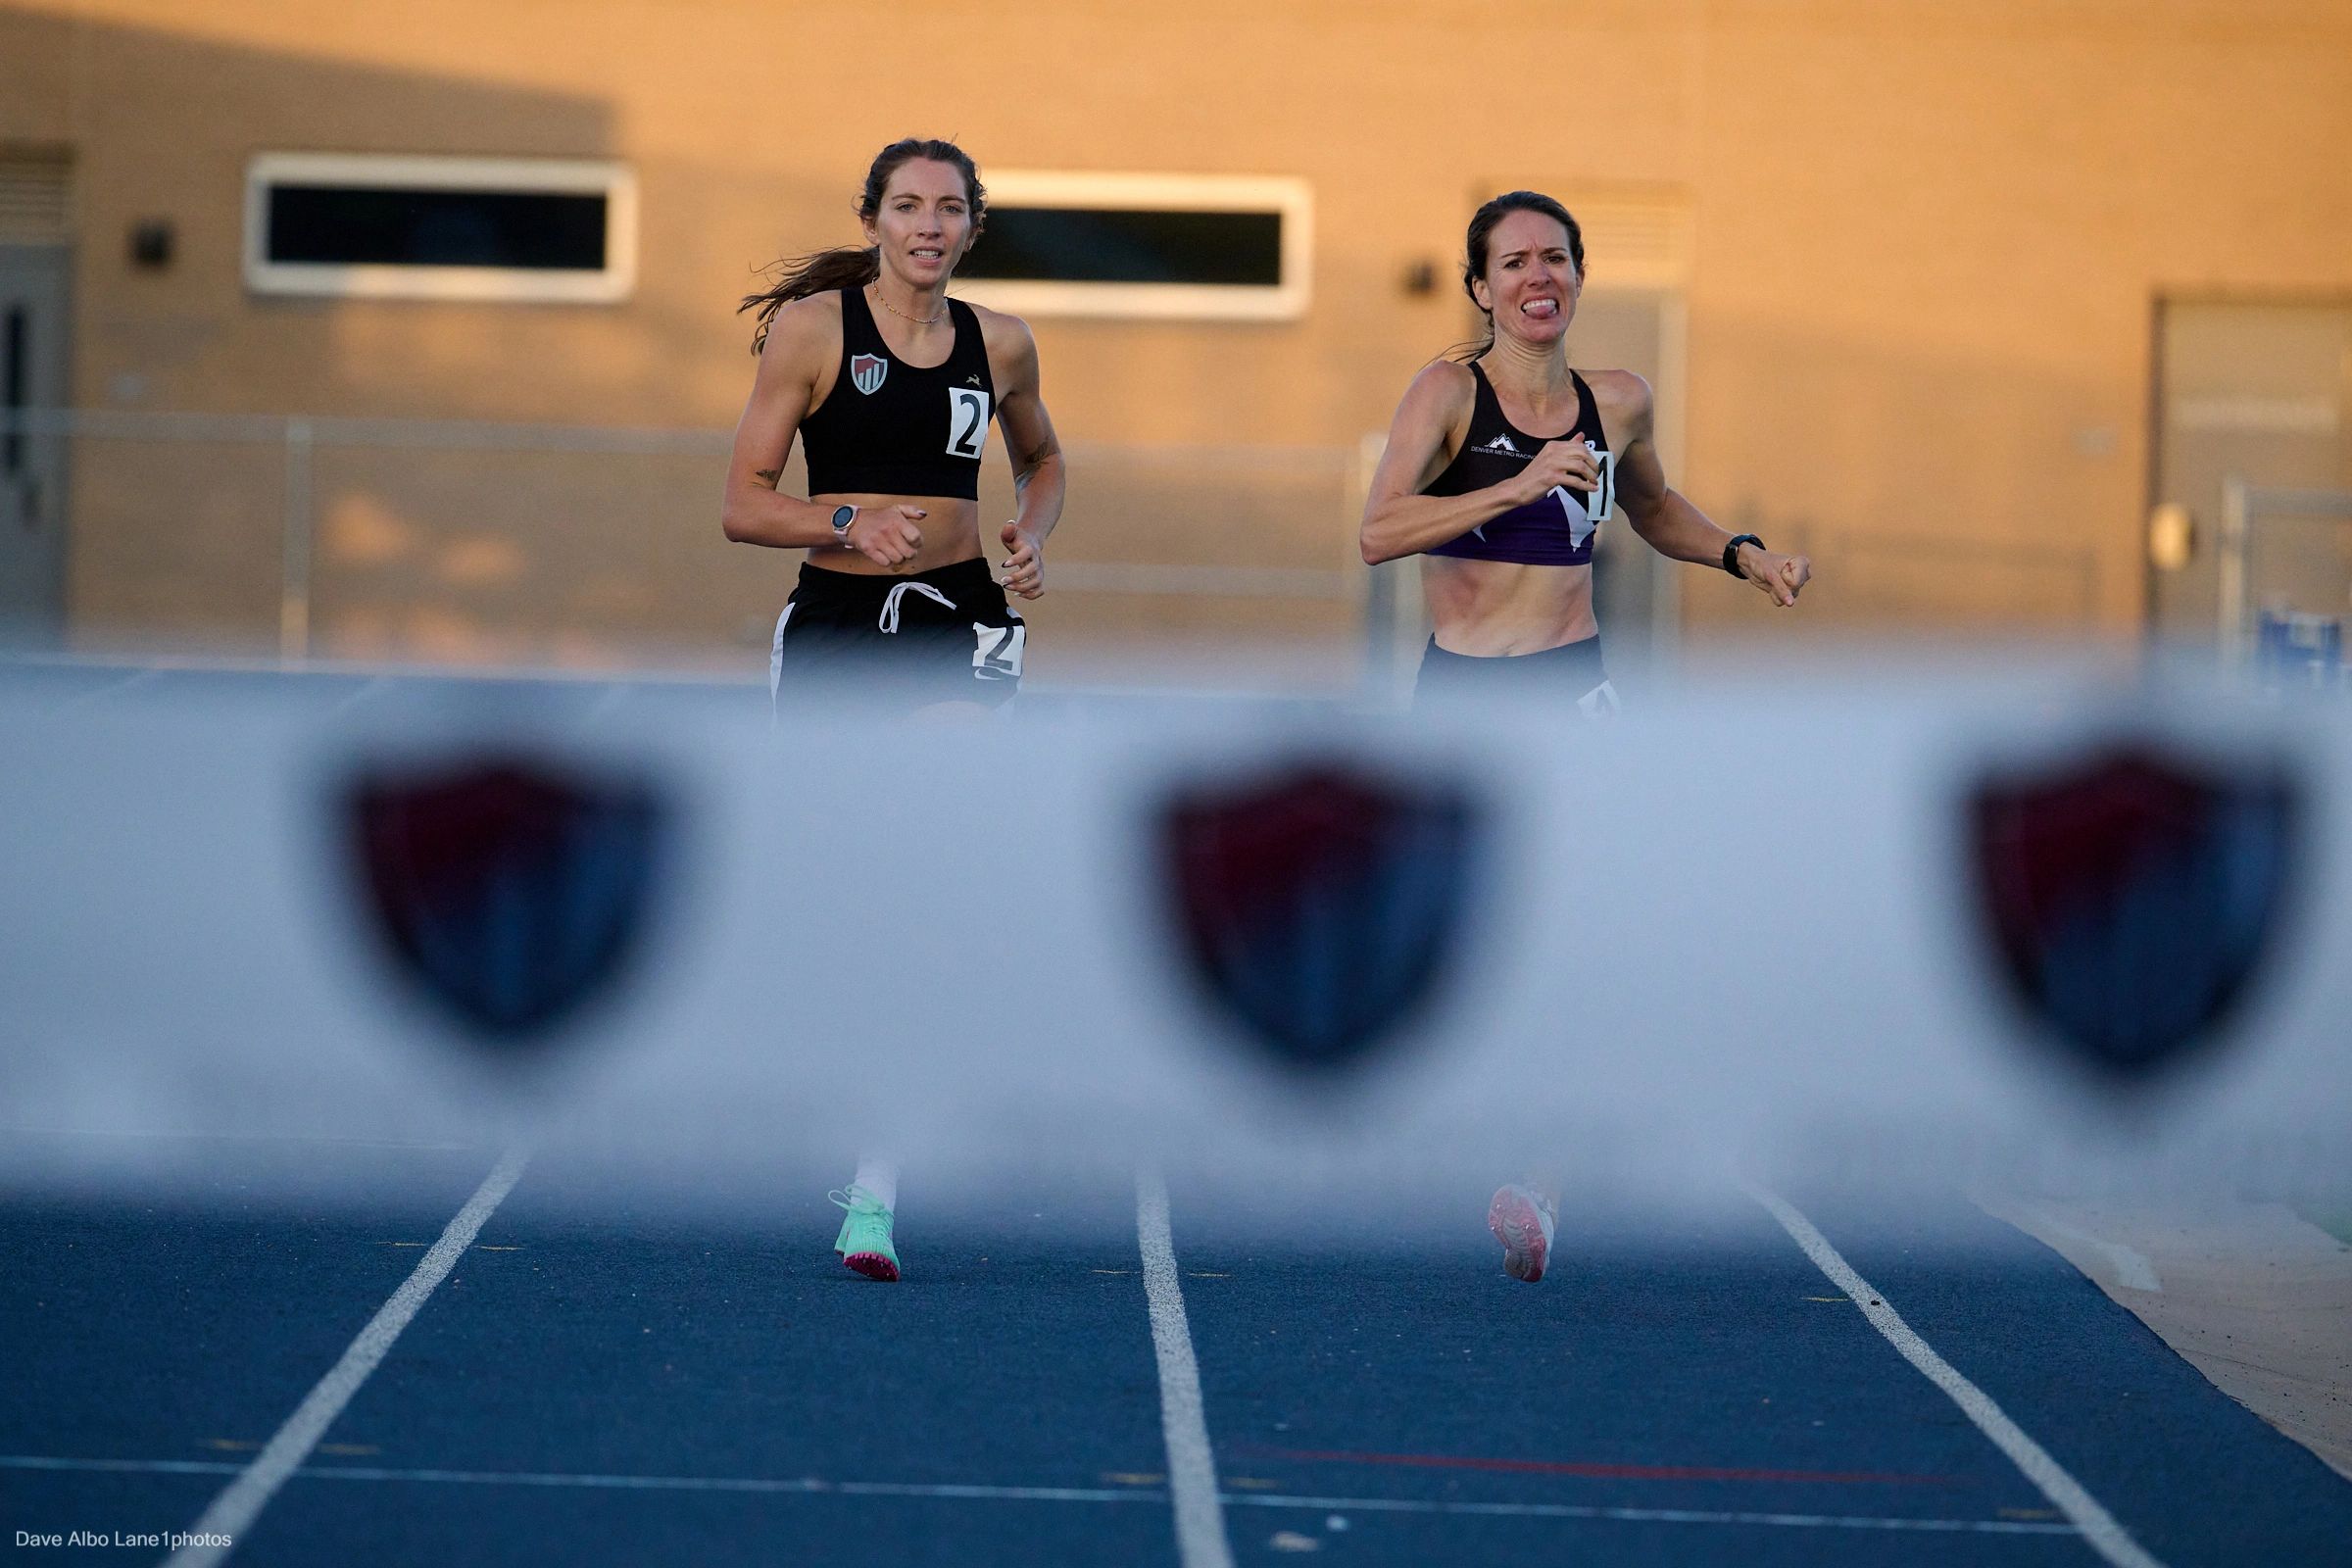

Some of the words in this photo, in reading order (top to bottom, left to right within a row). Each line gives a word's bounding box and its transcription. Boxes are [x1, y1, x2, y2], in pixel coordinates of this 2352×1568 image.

[955, 394, 981, 455] 2
[1470, 446, 1494, 455] DENVER
[984, 626, 1013, 671] 2
